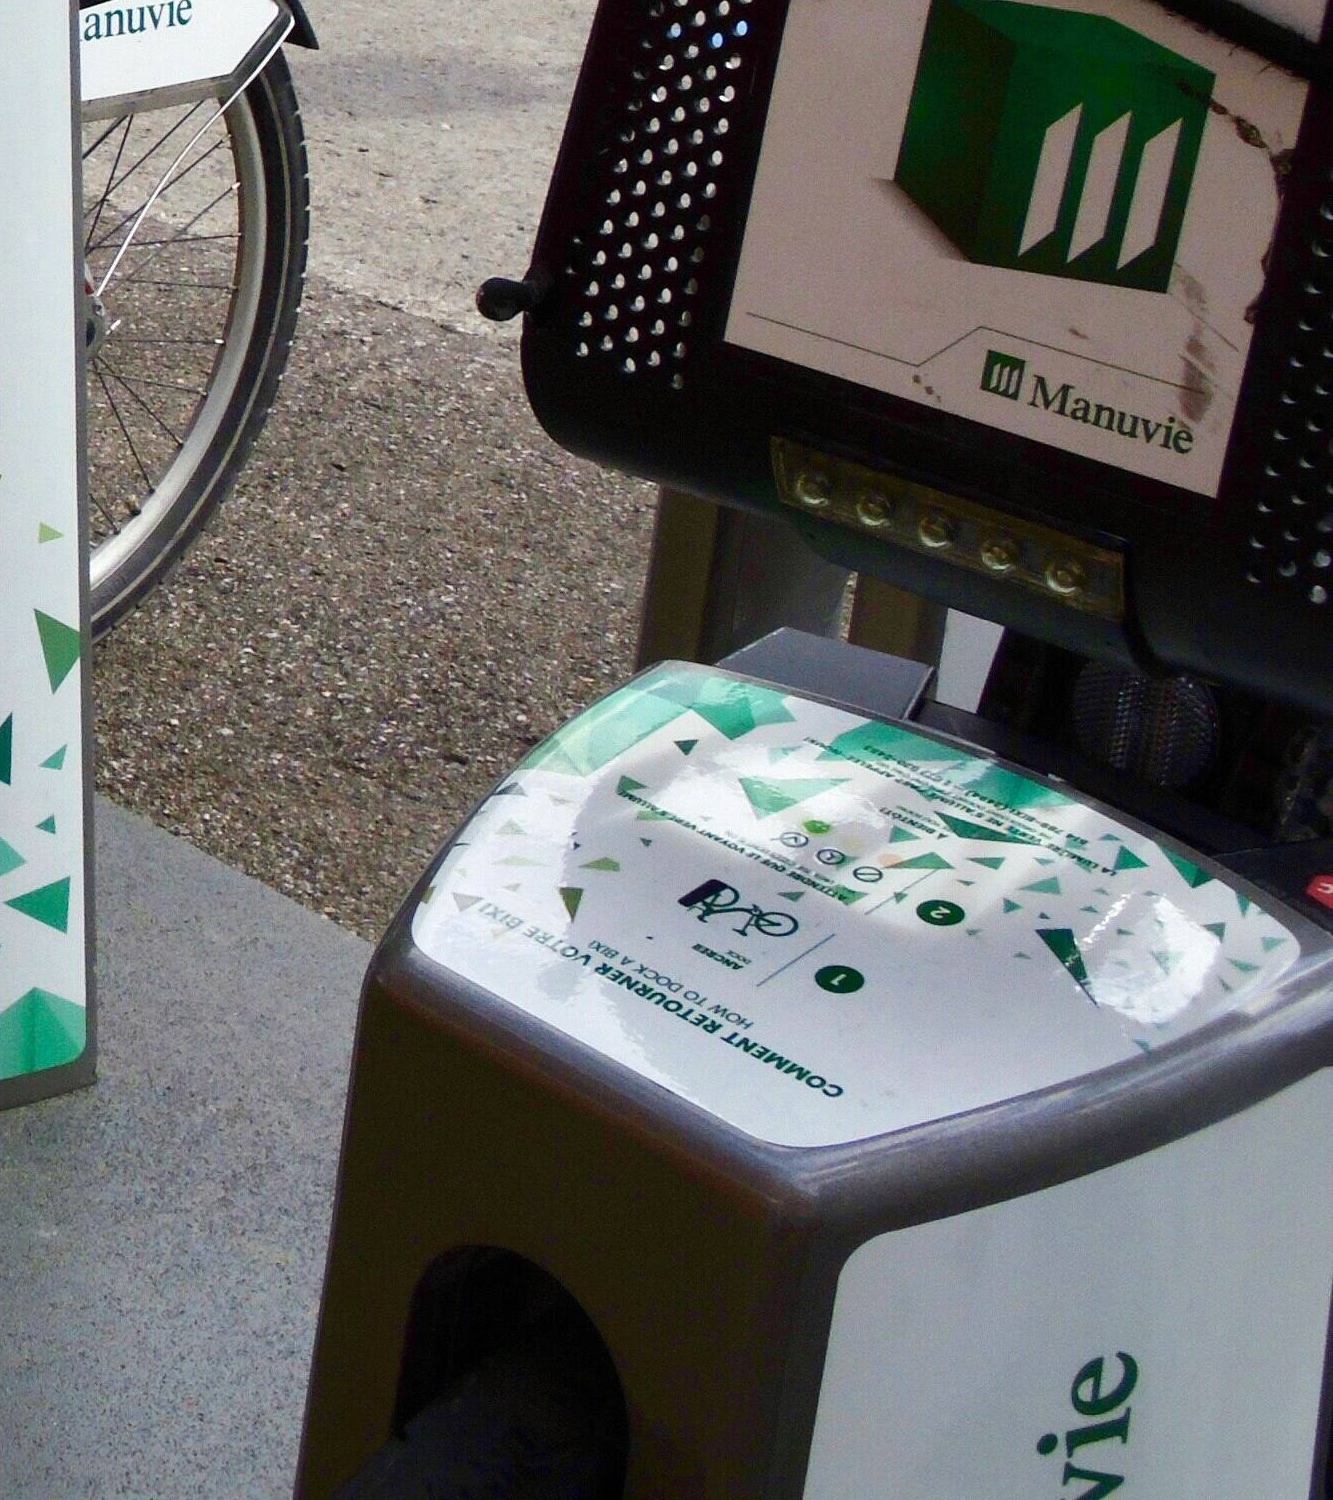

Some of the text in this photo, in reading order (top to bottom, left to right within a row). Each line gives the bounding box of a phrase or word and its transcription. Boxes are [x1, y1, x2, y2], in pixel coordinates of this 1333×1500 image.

[1028, 373, 1195, 455] Manuvie
[521, 924, 595, 967] VOTRE
[591, 961, 724, 1034] RETOURNER
[631, 963, 686, 993] DOCK
[678, 988, 711, 1007] TO
[706, 1002, 756, 1029] HOW
[719, 1030, 849, 1099] COMMENT
